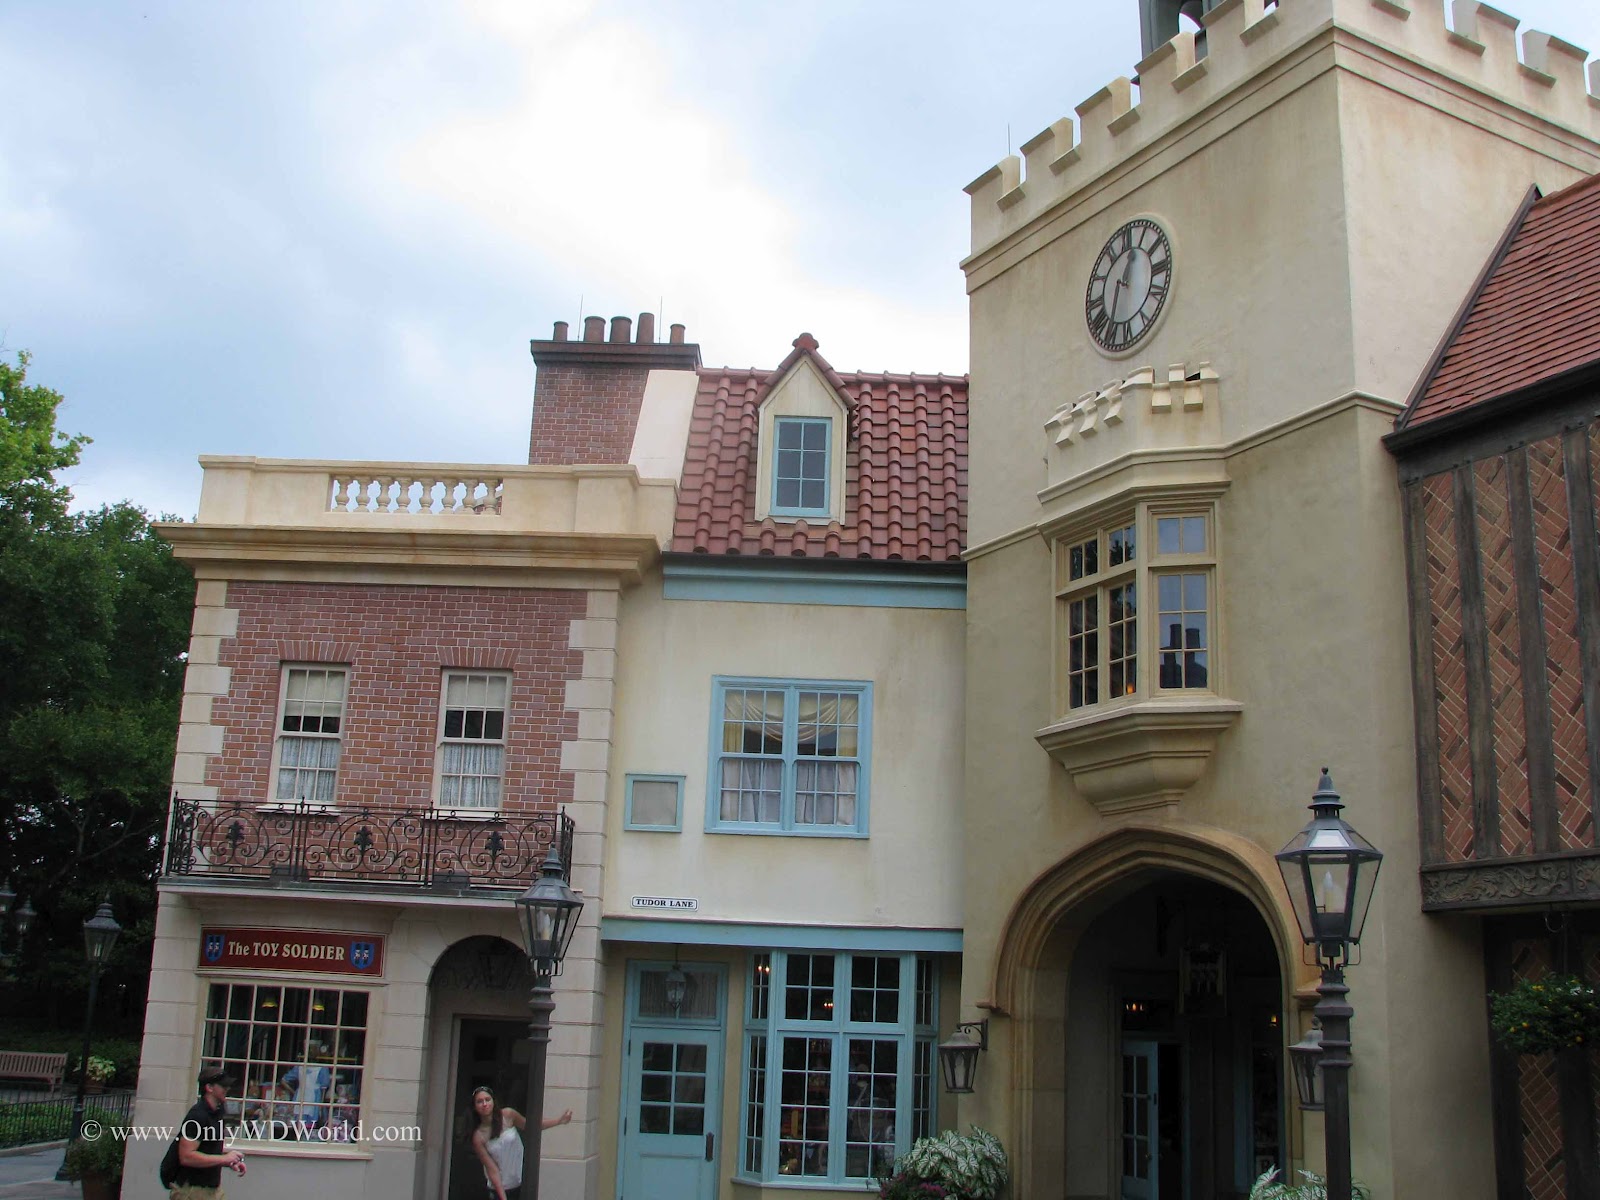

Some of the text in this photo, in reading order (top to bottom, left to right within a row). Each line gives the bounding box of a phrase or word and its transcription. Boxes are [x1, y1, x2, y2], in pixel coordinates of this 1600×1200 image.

[635, 899, 694, 908] TUDOR LANE
[228, 941, 345, 961] The TOY SOLDIER
